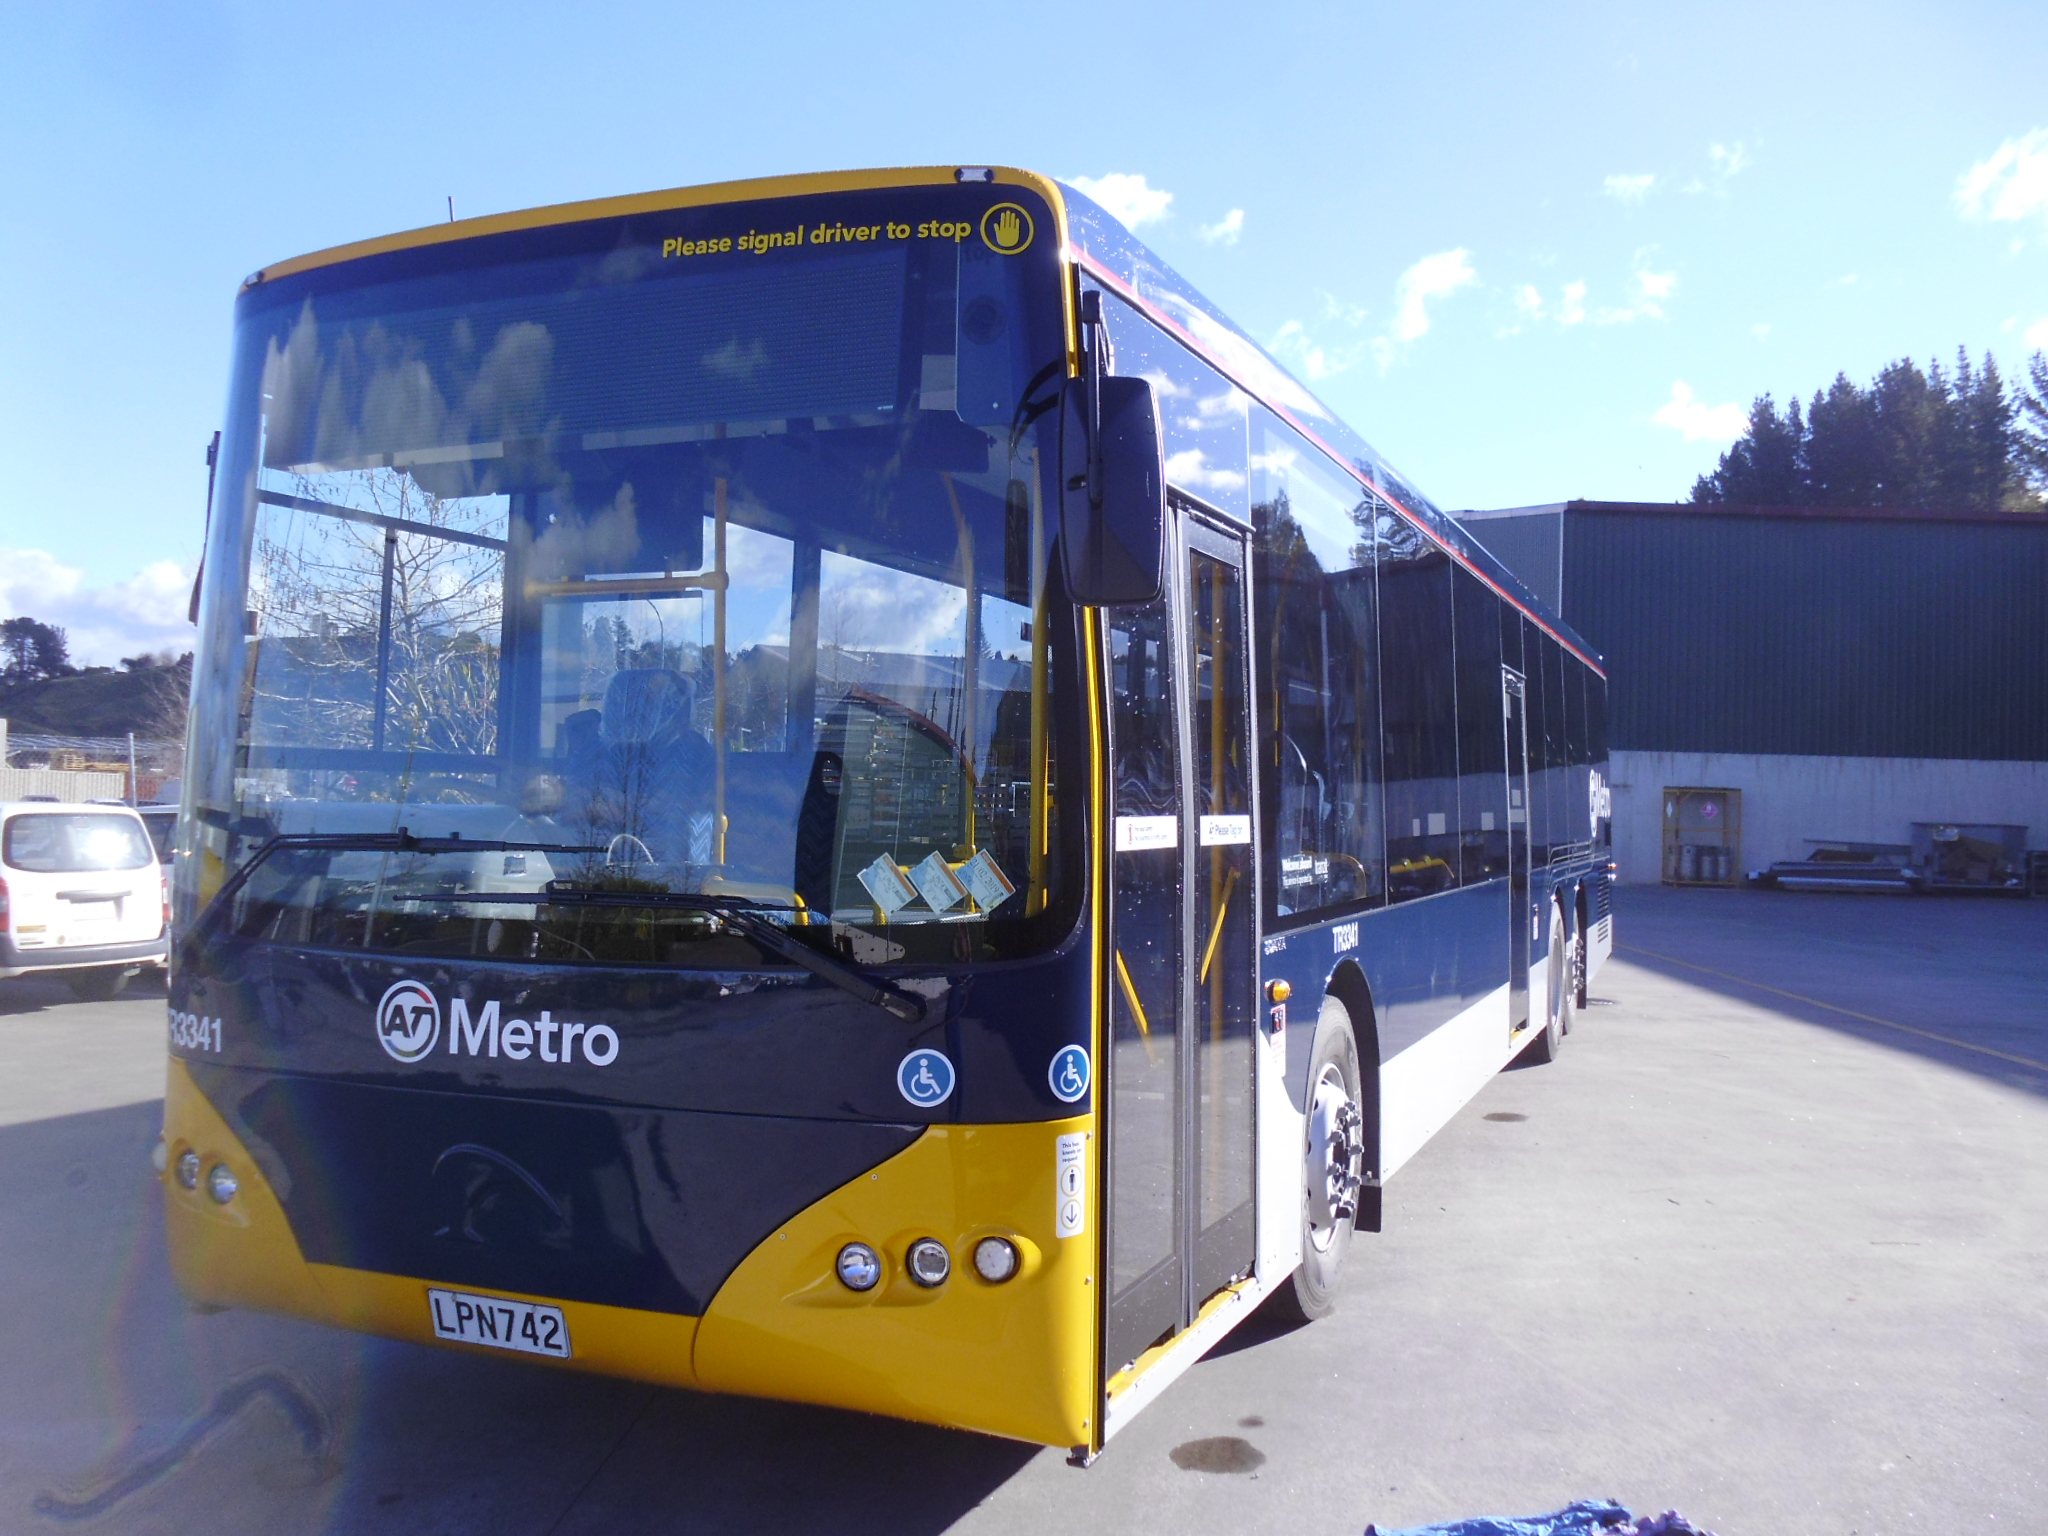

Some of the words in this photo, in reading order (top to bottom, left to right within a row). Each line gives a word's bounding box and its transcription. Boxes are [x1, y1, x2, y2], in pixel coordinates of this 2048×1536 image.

[662, 236, 731, 258] Please
[737, 225, 803, 255] signal
[810, 221, 881, 245] driver
[886, 220, 911, 239] to
[917, 219, 971, 243] stop
[449, 998, 619, 1066] Metro
[434, 1298, 562, 1350] LPN742
